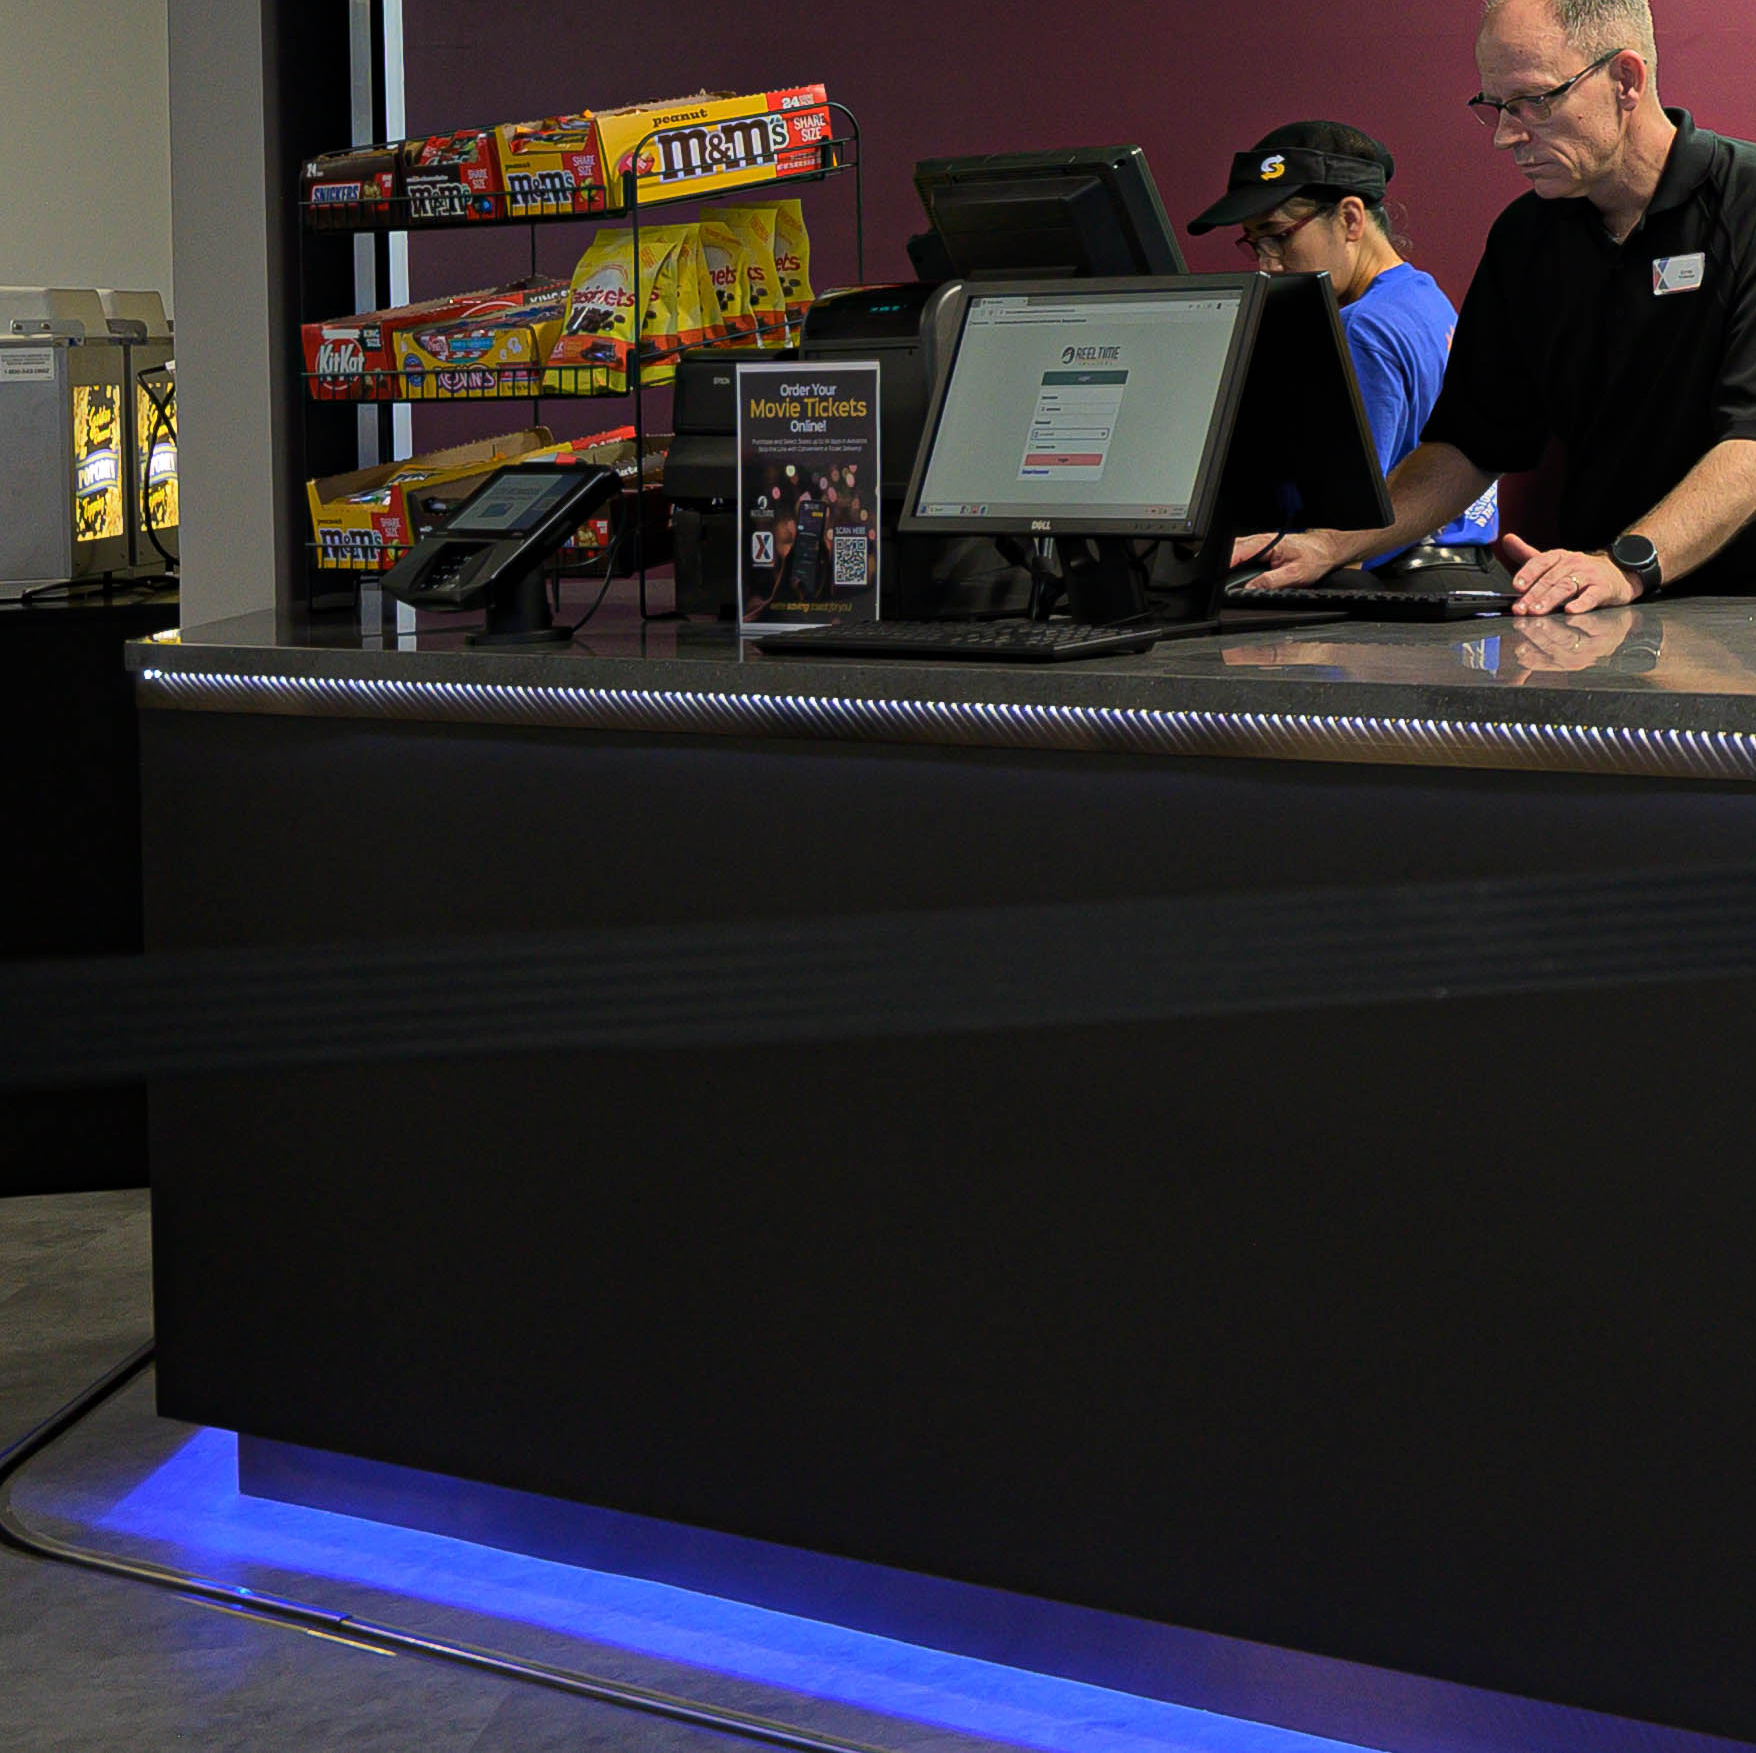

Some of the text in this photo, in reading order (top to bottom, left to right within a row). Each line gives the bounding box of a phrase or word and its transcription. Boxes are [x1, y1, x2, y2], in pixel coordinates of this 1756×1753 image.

[653, 109, 708, 128] peanut
[793, 113, 826, 131] SHARE
[801, 127, 822, 143] SIZE
[780, 384, 837, 397] Order Your
[751, 398, 867, 418] Movie Tickets
[790, 420, 827, 433] Online!
